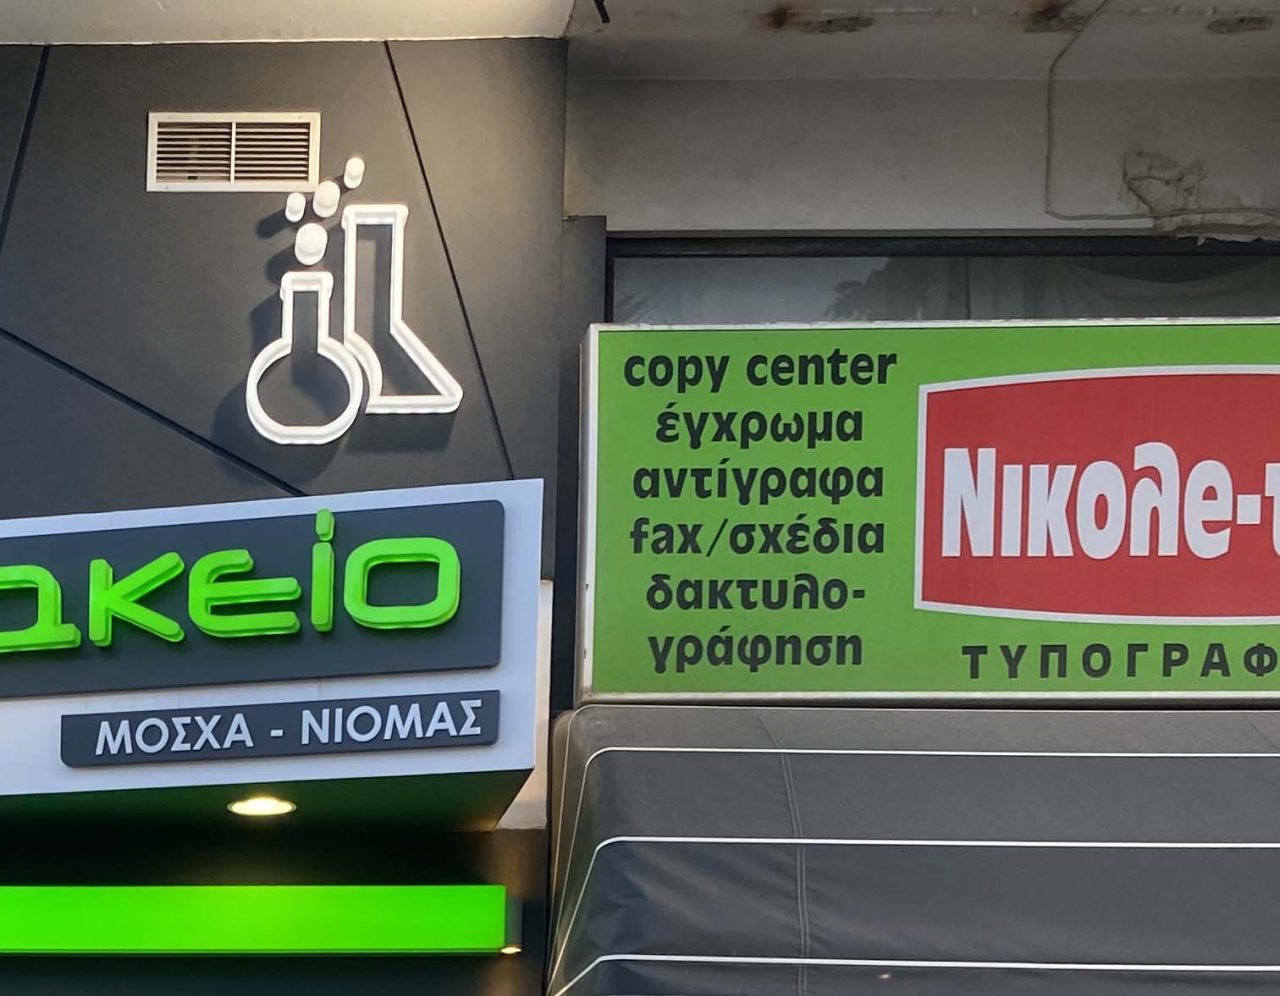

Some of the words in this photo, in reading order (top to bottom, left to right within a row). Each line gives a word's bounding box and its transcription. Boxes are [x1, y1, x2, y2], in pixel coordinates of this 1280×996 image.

[624, 353, 730, 393] copy
[746, 348, 897, 386] center
[655, 403, 863, 449] έγχρωμα
[633, 458, 884, 504] αντίγραφα
[630, 515, 885, 557] fax/σχέδια
[646, 573, 866, 610] δακτυλο-
[648, 626, 863, 672] γράφηση
[962, 642, 1278, 680] ΤΥΠΟΓΡΑΦ
[94, 708, 255, 756] ΜΟΣΧΑ
[301, 698, 485, 746] ΝΙΟΜΑΣ
